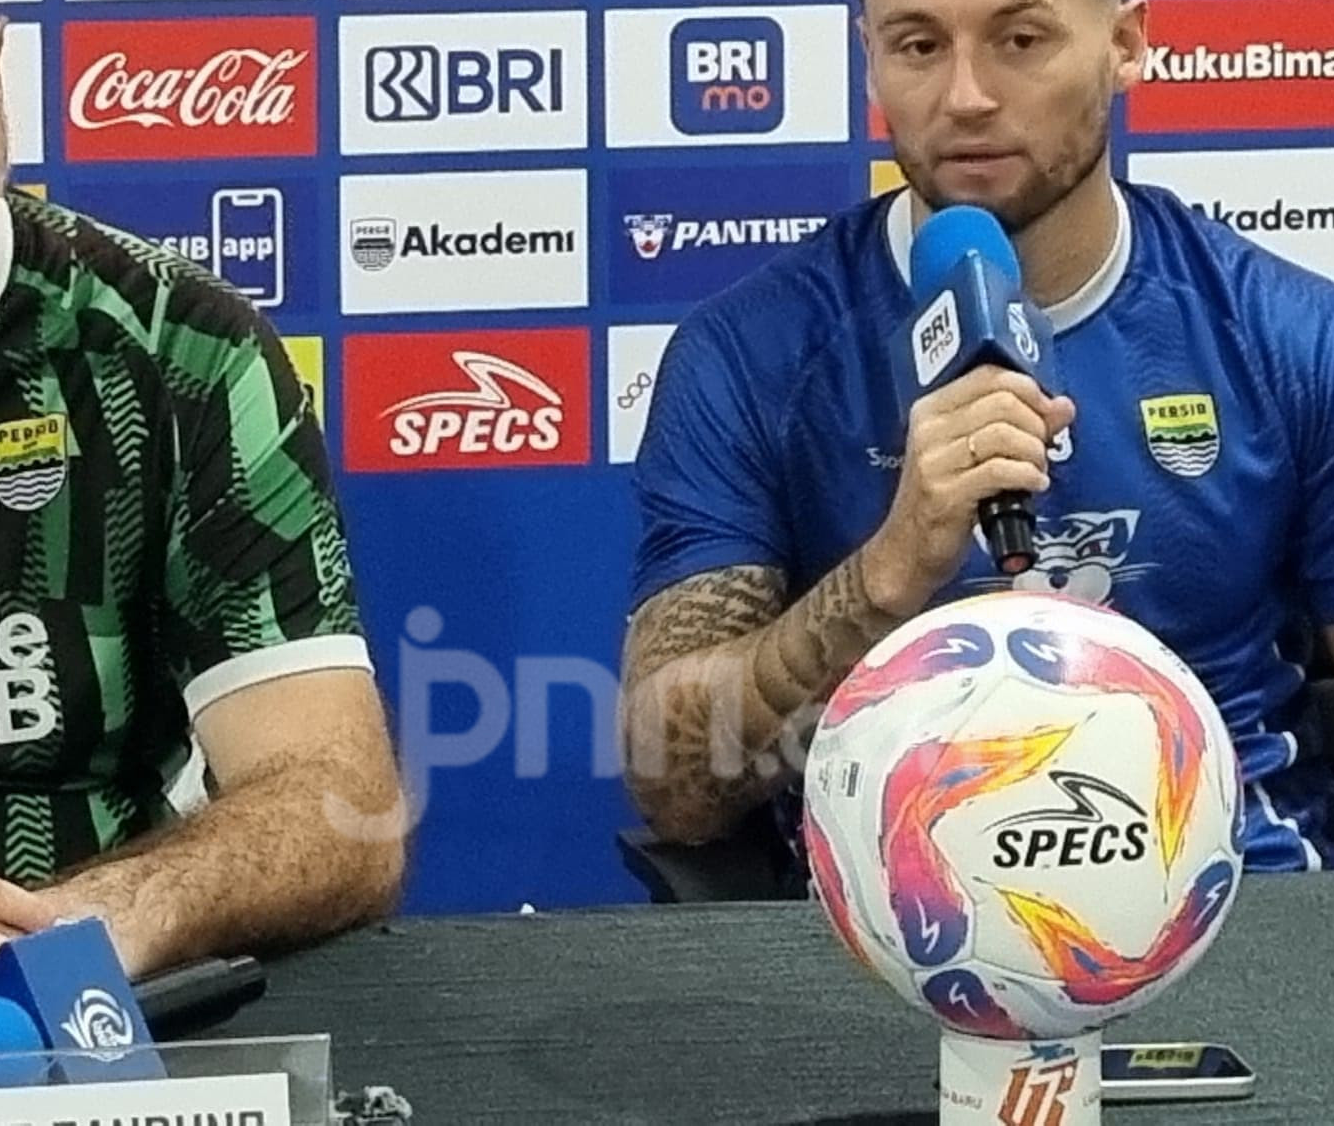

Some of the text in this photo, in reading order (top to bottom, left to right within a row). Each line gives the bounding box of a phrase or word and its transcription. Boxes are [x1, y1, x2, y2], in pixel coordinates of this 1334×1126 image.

[450, 48, 562, 113] BRI
[687, 41, 766, 82] BRI
[70, 48, 309, 128] Coca-Cola
[703, 84, 770, 110] mo
[223, 237, 273, 261] app
[400, 223, 574, 257] Akademi
[920, 309, 950, 354] BRI
[390, 408, 562, 456] SPECS
[993, 823, 1148, 868] SPECS
